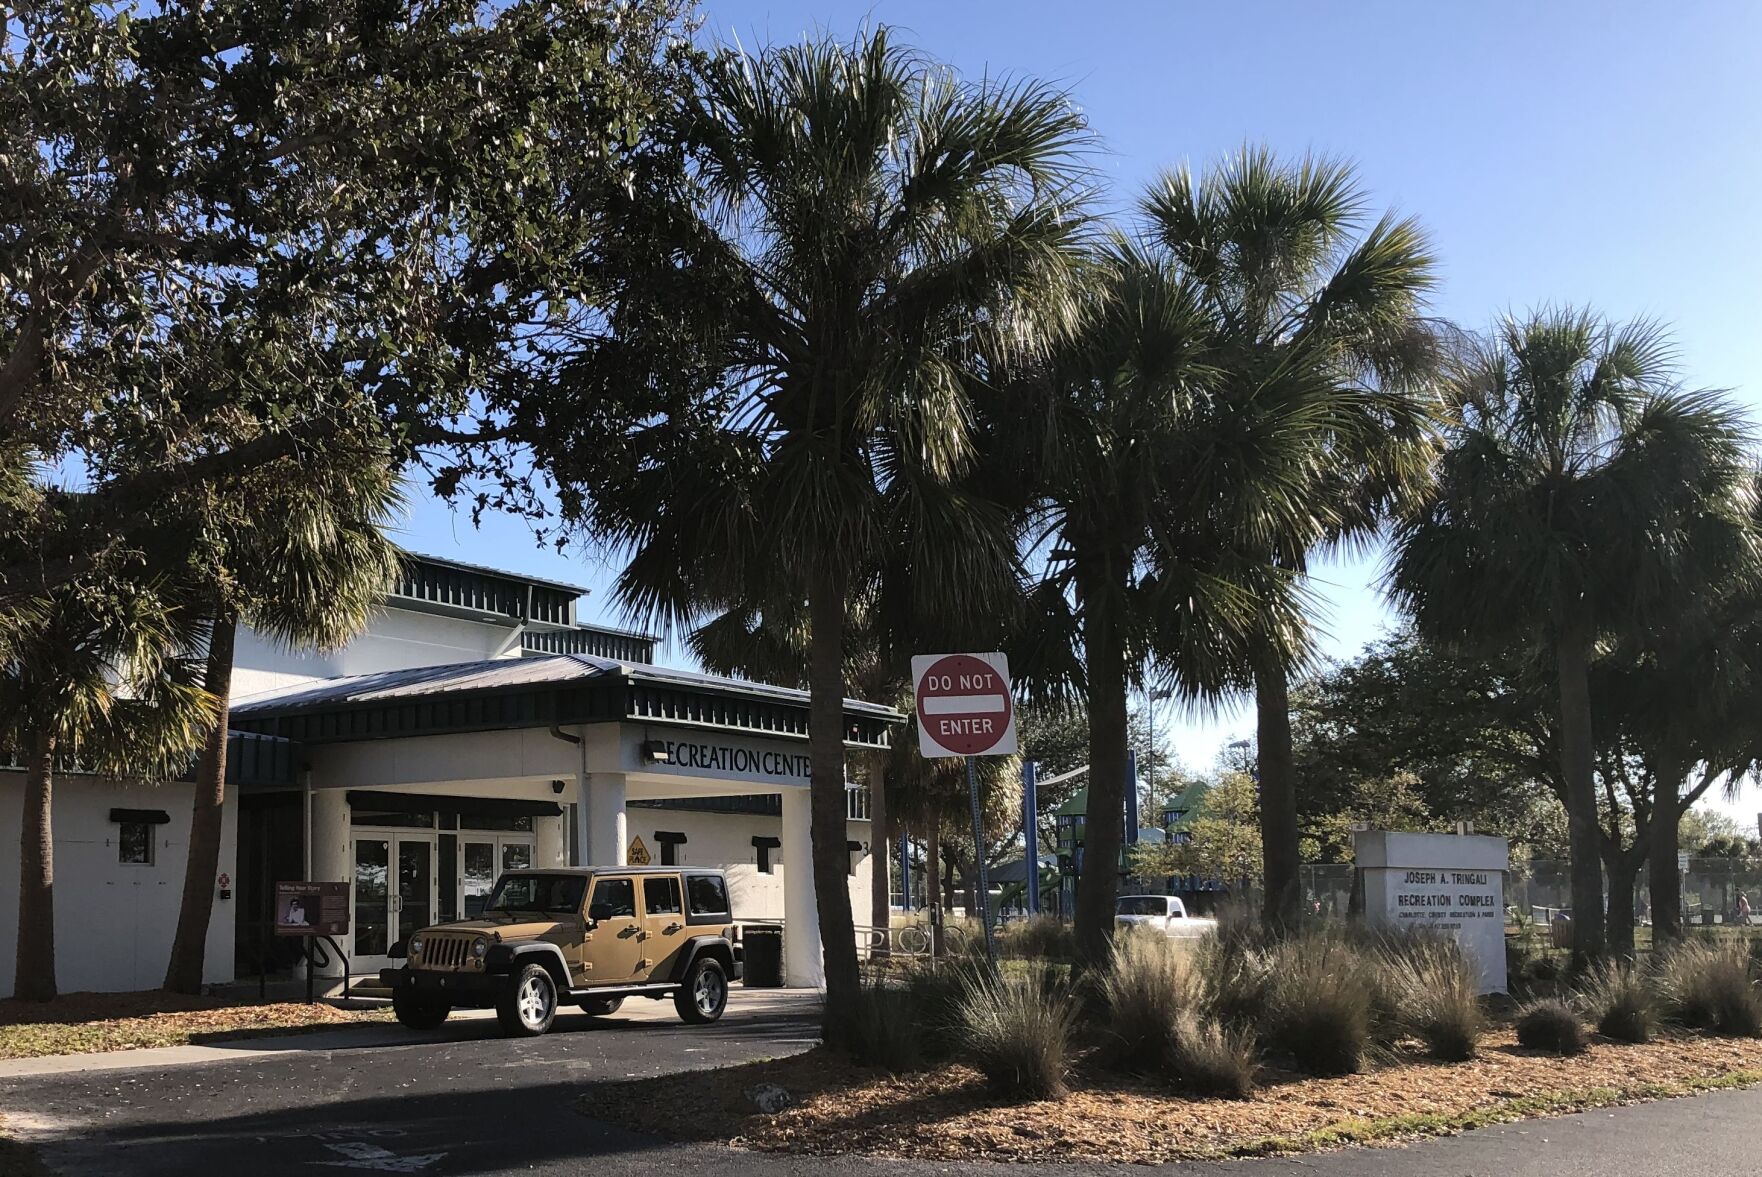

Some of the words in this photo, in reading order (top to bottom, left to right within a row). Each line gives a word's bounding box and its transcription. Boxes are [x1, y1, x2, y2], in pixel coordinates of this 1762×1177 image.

[928, 676, 951, 690] DO
[959, 674, 993, 690] NOT
[940, 718, 993, 736] ENTER
[656, 741, 760, 773] ECREATION
[762, 752, 812, 777] CENTE
[631, 847, 644, 856] SAFE
[628, 855, 647, 864] PLACE
[1404, 871, 1436, 884] JOSEPH
[1440, 872, 1449, 884] A.
[1452, 872, 1487, 886] TRINGALI
[1398, 894, 1451, 907] RECREATION
[1459, 894, 1495, 907] COMPLEX
